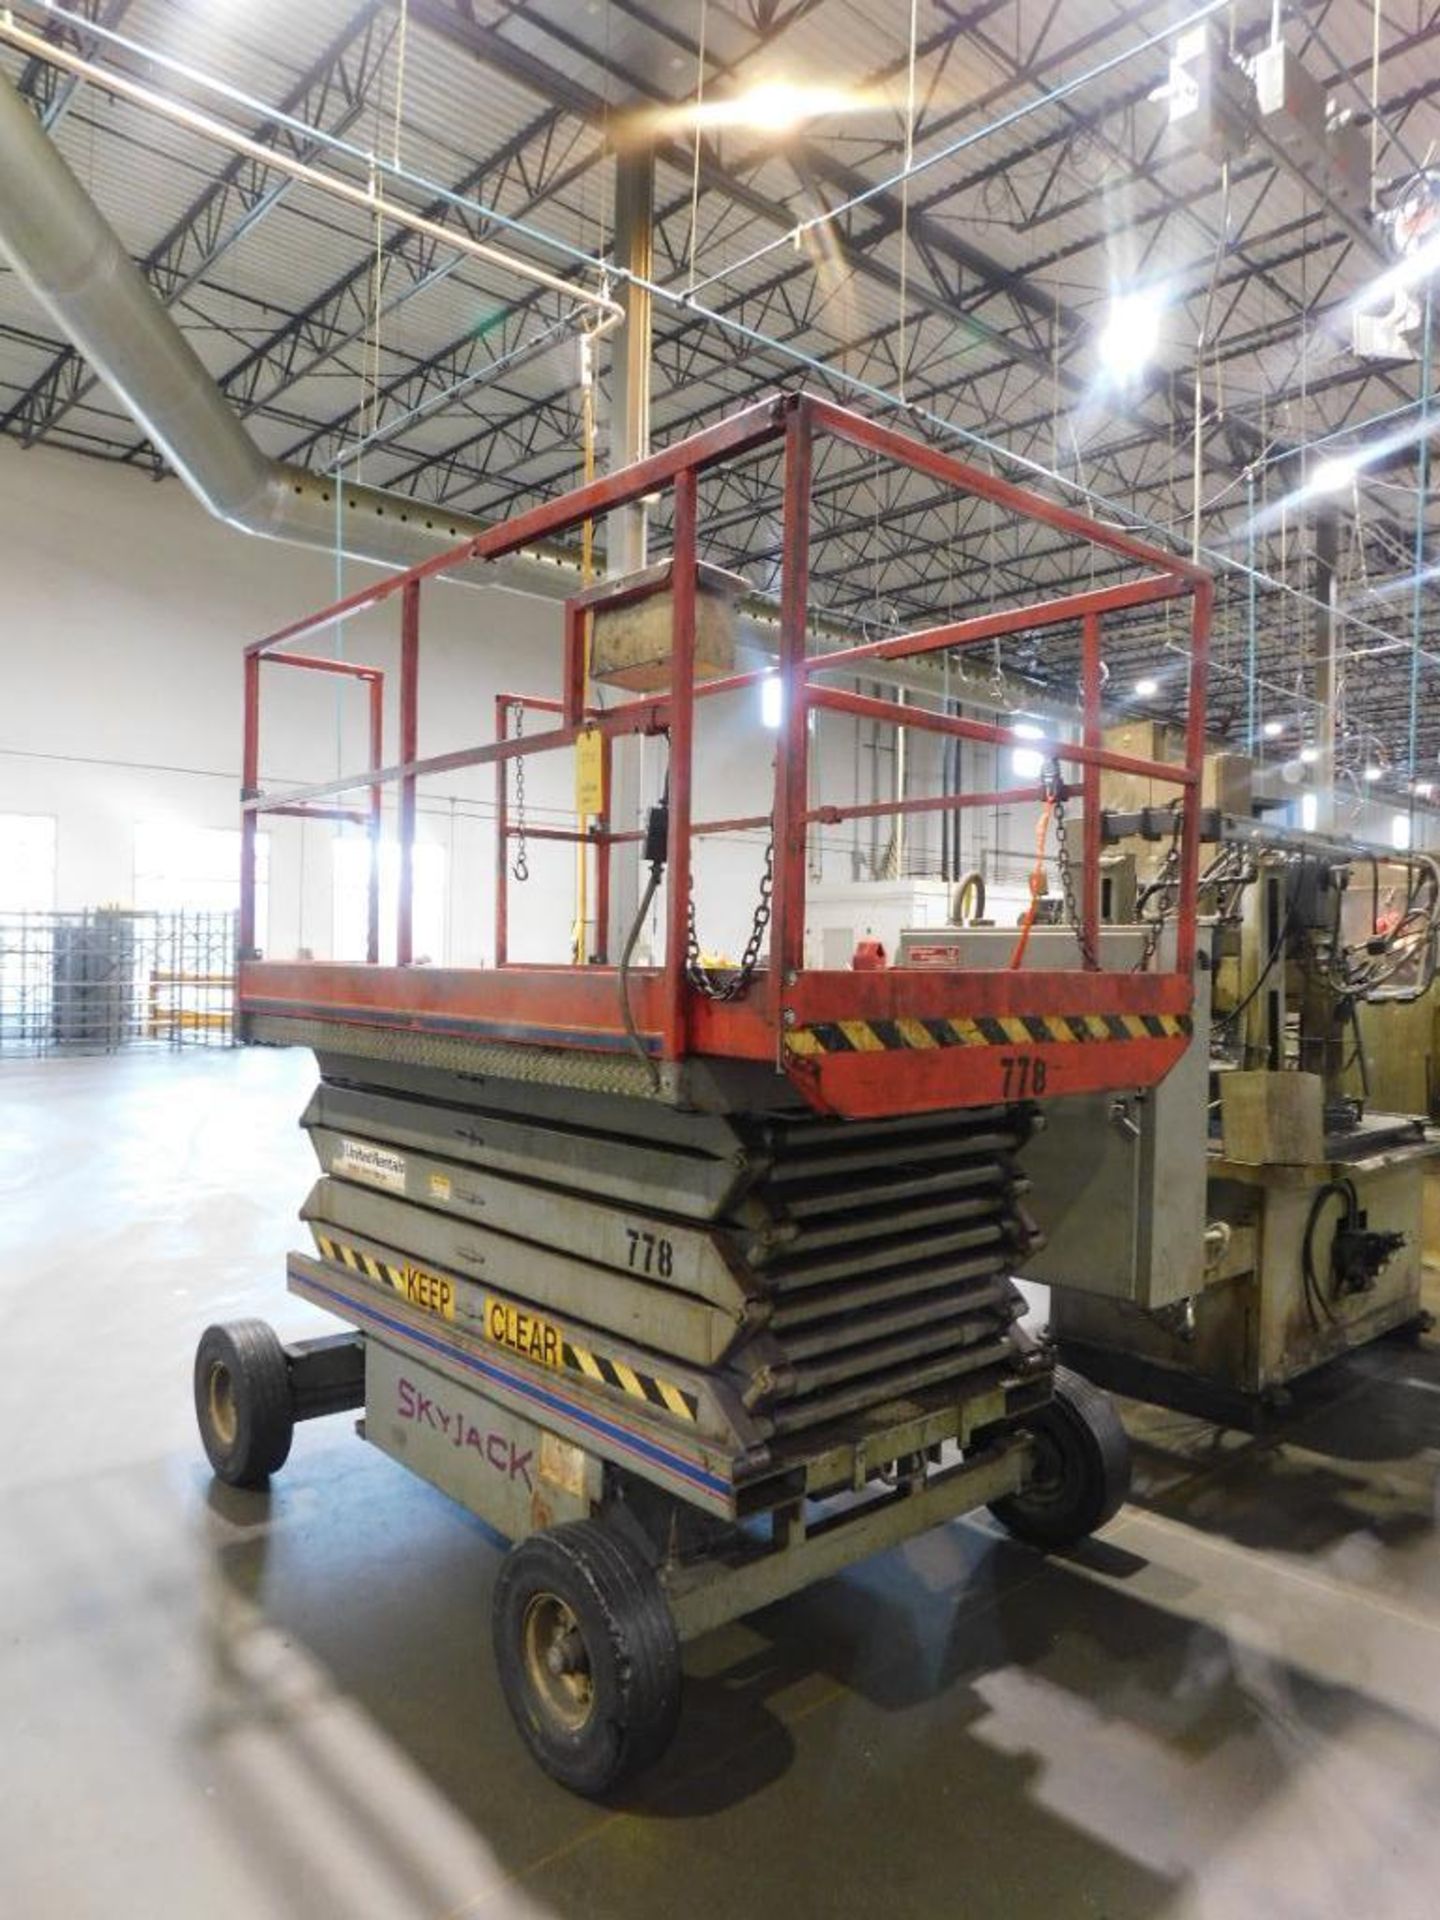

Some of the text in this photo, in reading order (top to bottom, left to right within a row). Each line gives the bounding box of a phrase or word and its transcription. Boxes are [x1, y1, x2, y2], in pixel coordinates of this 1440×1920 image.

[1001, 1056, 1046, 1098] 778
[626, 1228, 673, 1278] 778
[407, 1267, 557, 1366] KEEP CLEAR
[397, 1378, 533, 1493] SKYJACK
